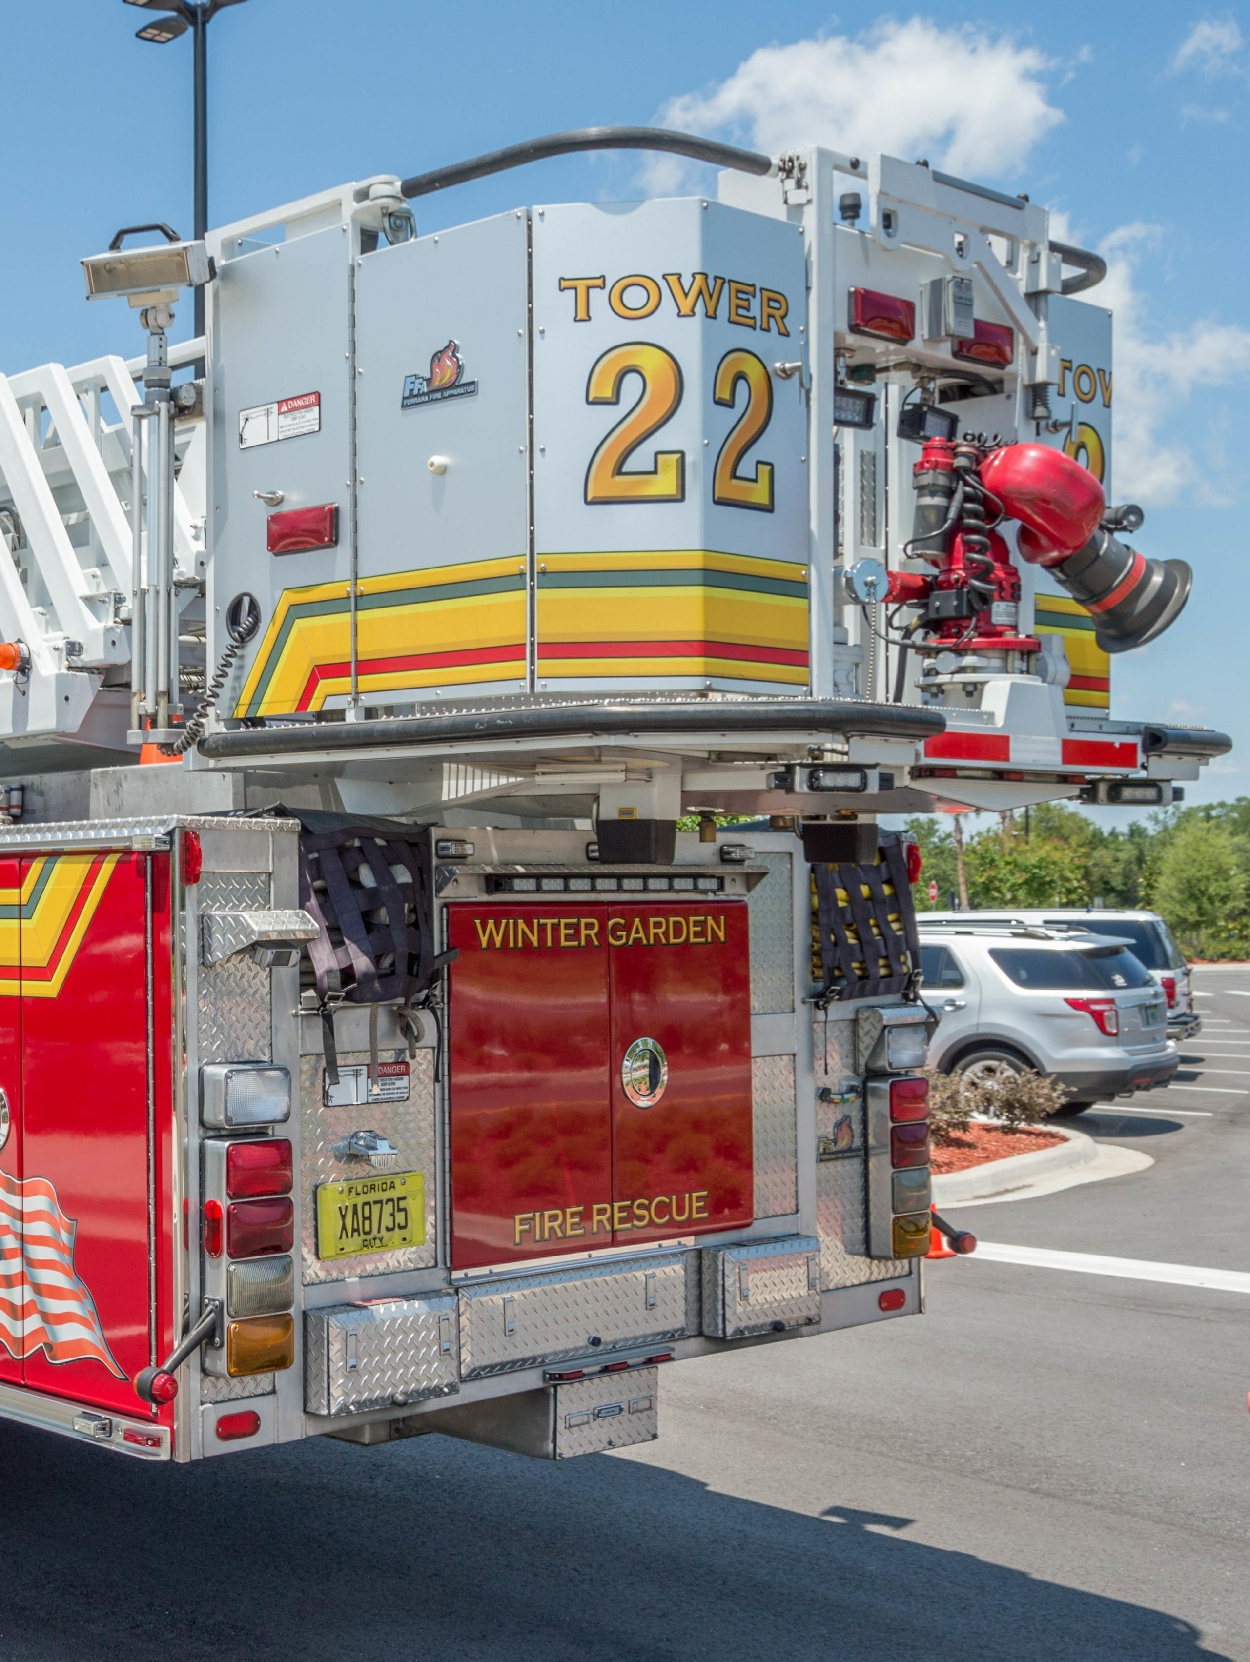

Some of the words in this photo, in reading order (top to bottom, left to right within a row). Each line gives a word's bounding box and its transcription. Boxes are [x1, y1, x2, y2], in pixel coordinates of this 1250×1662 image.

[558, 271, 790, 338] TOWER
[403, 375, 428, 398] FFA
[403, 395, 429, 407] FERRARA
[429, 392, 442, 401] FIRE
[443, 384, 475, 398] APPARATUS
[287, 394, 316, 409] DANGER
[583, 340, 776, 514] 22
[473, 916, 601, 950] WINTER
[607, 914, 727, 948] GARDEN
[378, 1064, 406, 1075] DANGER
[348, 1180, 396, 1197] FLORIDA
[338, 1196, 409, 1240] XA8735
[513, 1206, 586, 1246] FIRE
[591, 1190, 711, 1235] RESCUE
[362, 1235, 385, 1248] CITY
